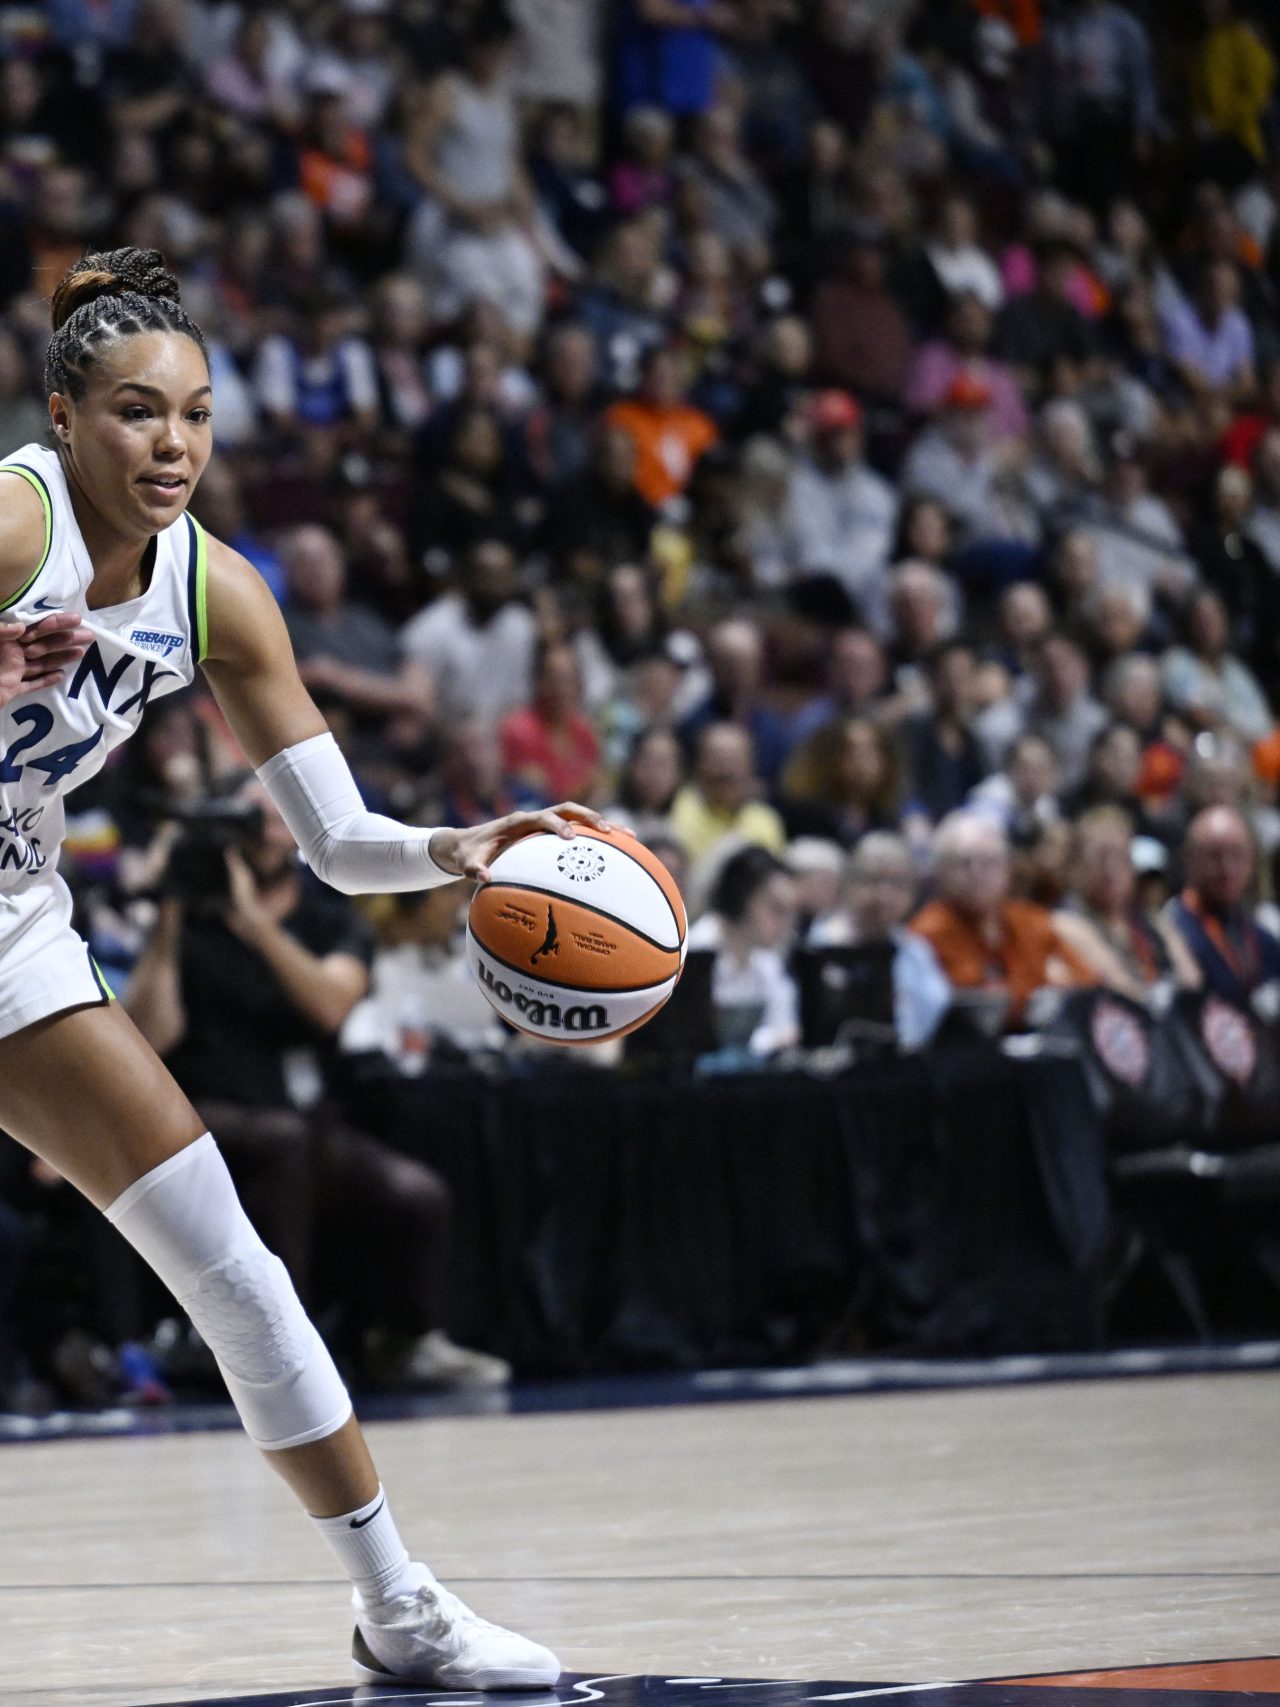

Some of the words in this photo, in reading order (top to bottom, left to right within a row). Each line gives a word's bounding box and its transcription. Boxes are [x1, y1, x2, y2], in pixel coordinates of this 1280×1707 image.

[130, 630, 184, 648] FEDERATED
[67, 641, 178, 715] NX
[478, 958, 611, 1031] Wilson
